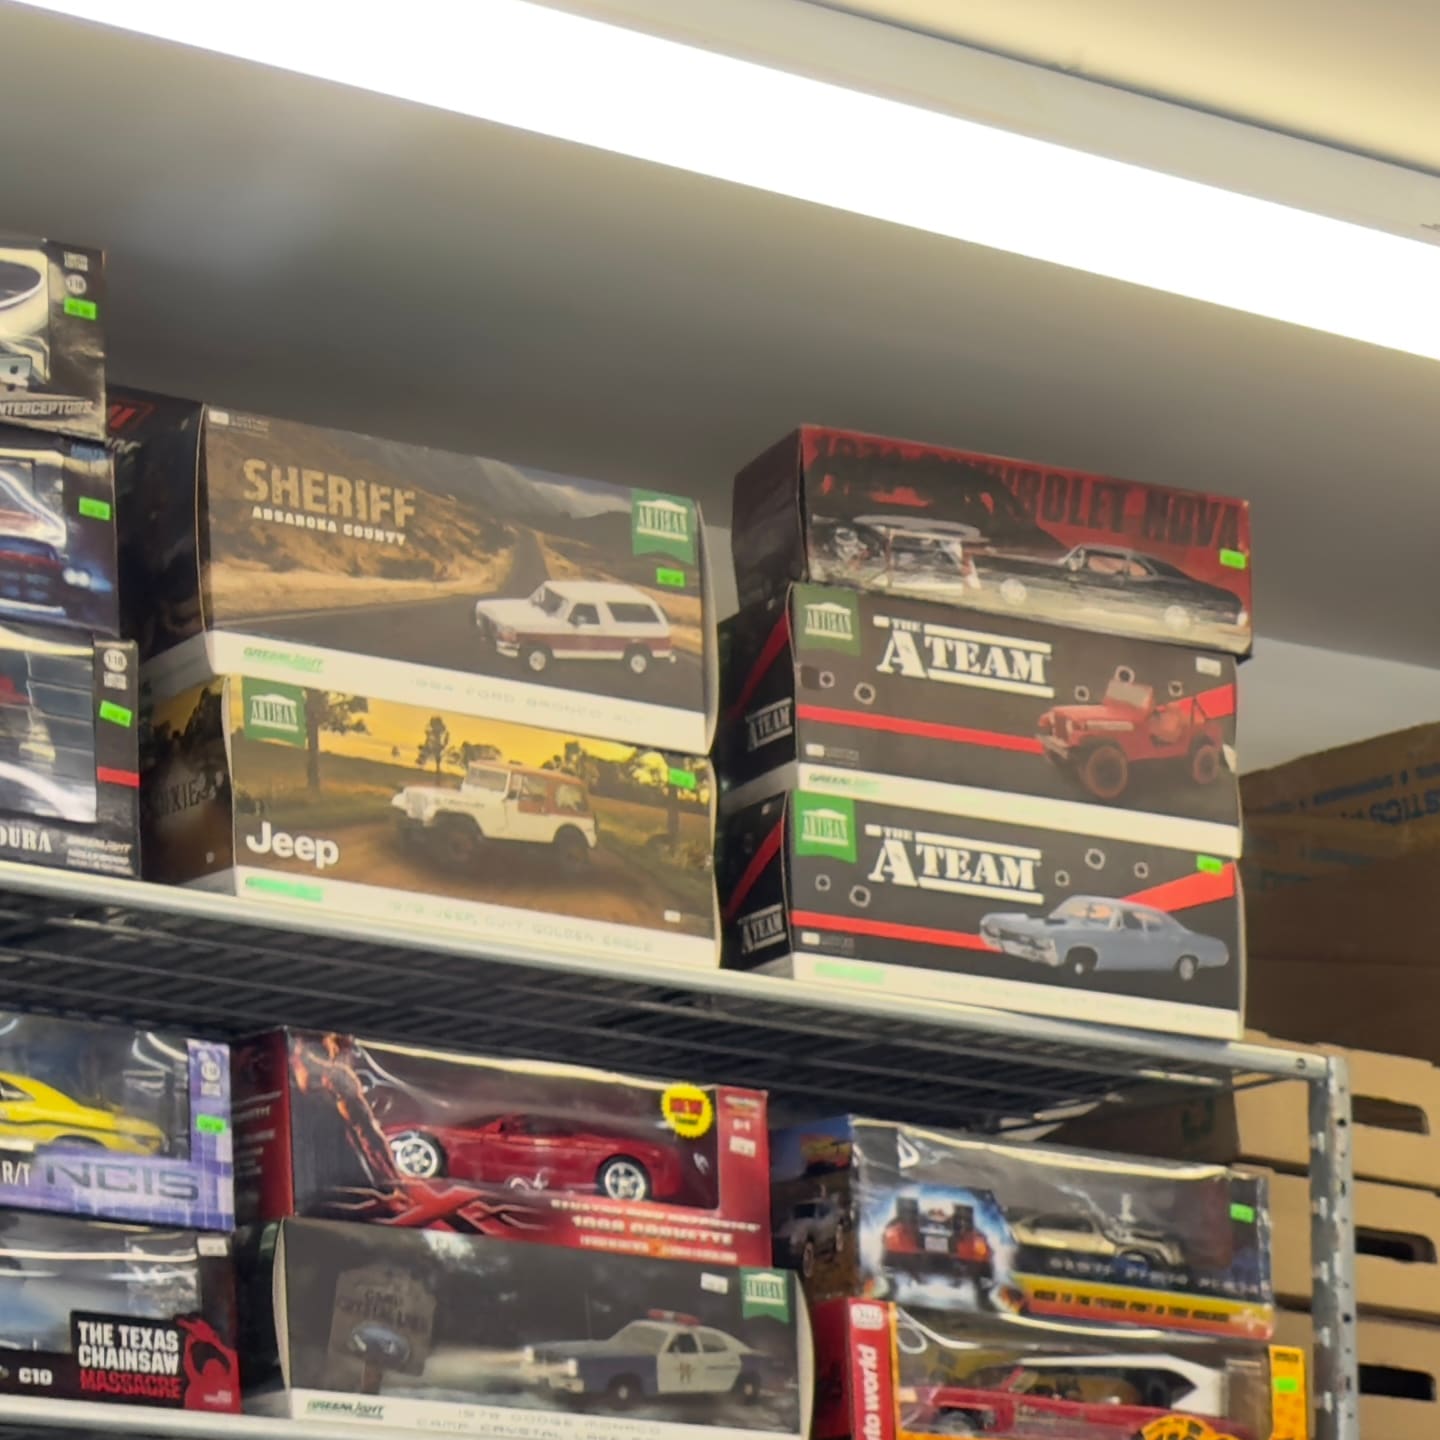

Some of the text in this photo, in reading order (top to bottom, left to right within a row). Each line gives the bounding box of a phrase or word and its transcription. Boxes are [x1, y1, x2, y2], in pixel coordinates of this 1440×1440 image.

[0, 401, 93, 417] NTERCEPTORS
[243, 458, 416, 528] SHERIFF
[252, 506, 406, 545] ABSAROKA COUNTY
[638, 508, 686, 536] ARTISAN
[805, 612, 852, 635] ARTISAN
[892, 617, 922, 632] THE
[877, 627, 1050, 686] A TEAM
[252, 702, 298, 723] ARTISAN
[0, 828, 52, 853] DURA
[246, 822, 339, 868] Jeep
[868, 841, 1040, 891] A TEAM
[2, 1160, 32, 1187] R/T
[47, 1160, 199, 1201] NCIS
[78, 1320, 179, 1353] THE TEXAS
[78, 1346, 180, 1375] CHAINSAW
[19, 1367, 53, 1386] C10
[79, 1369, 182, 1398] MASSACRE
